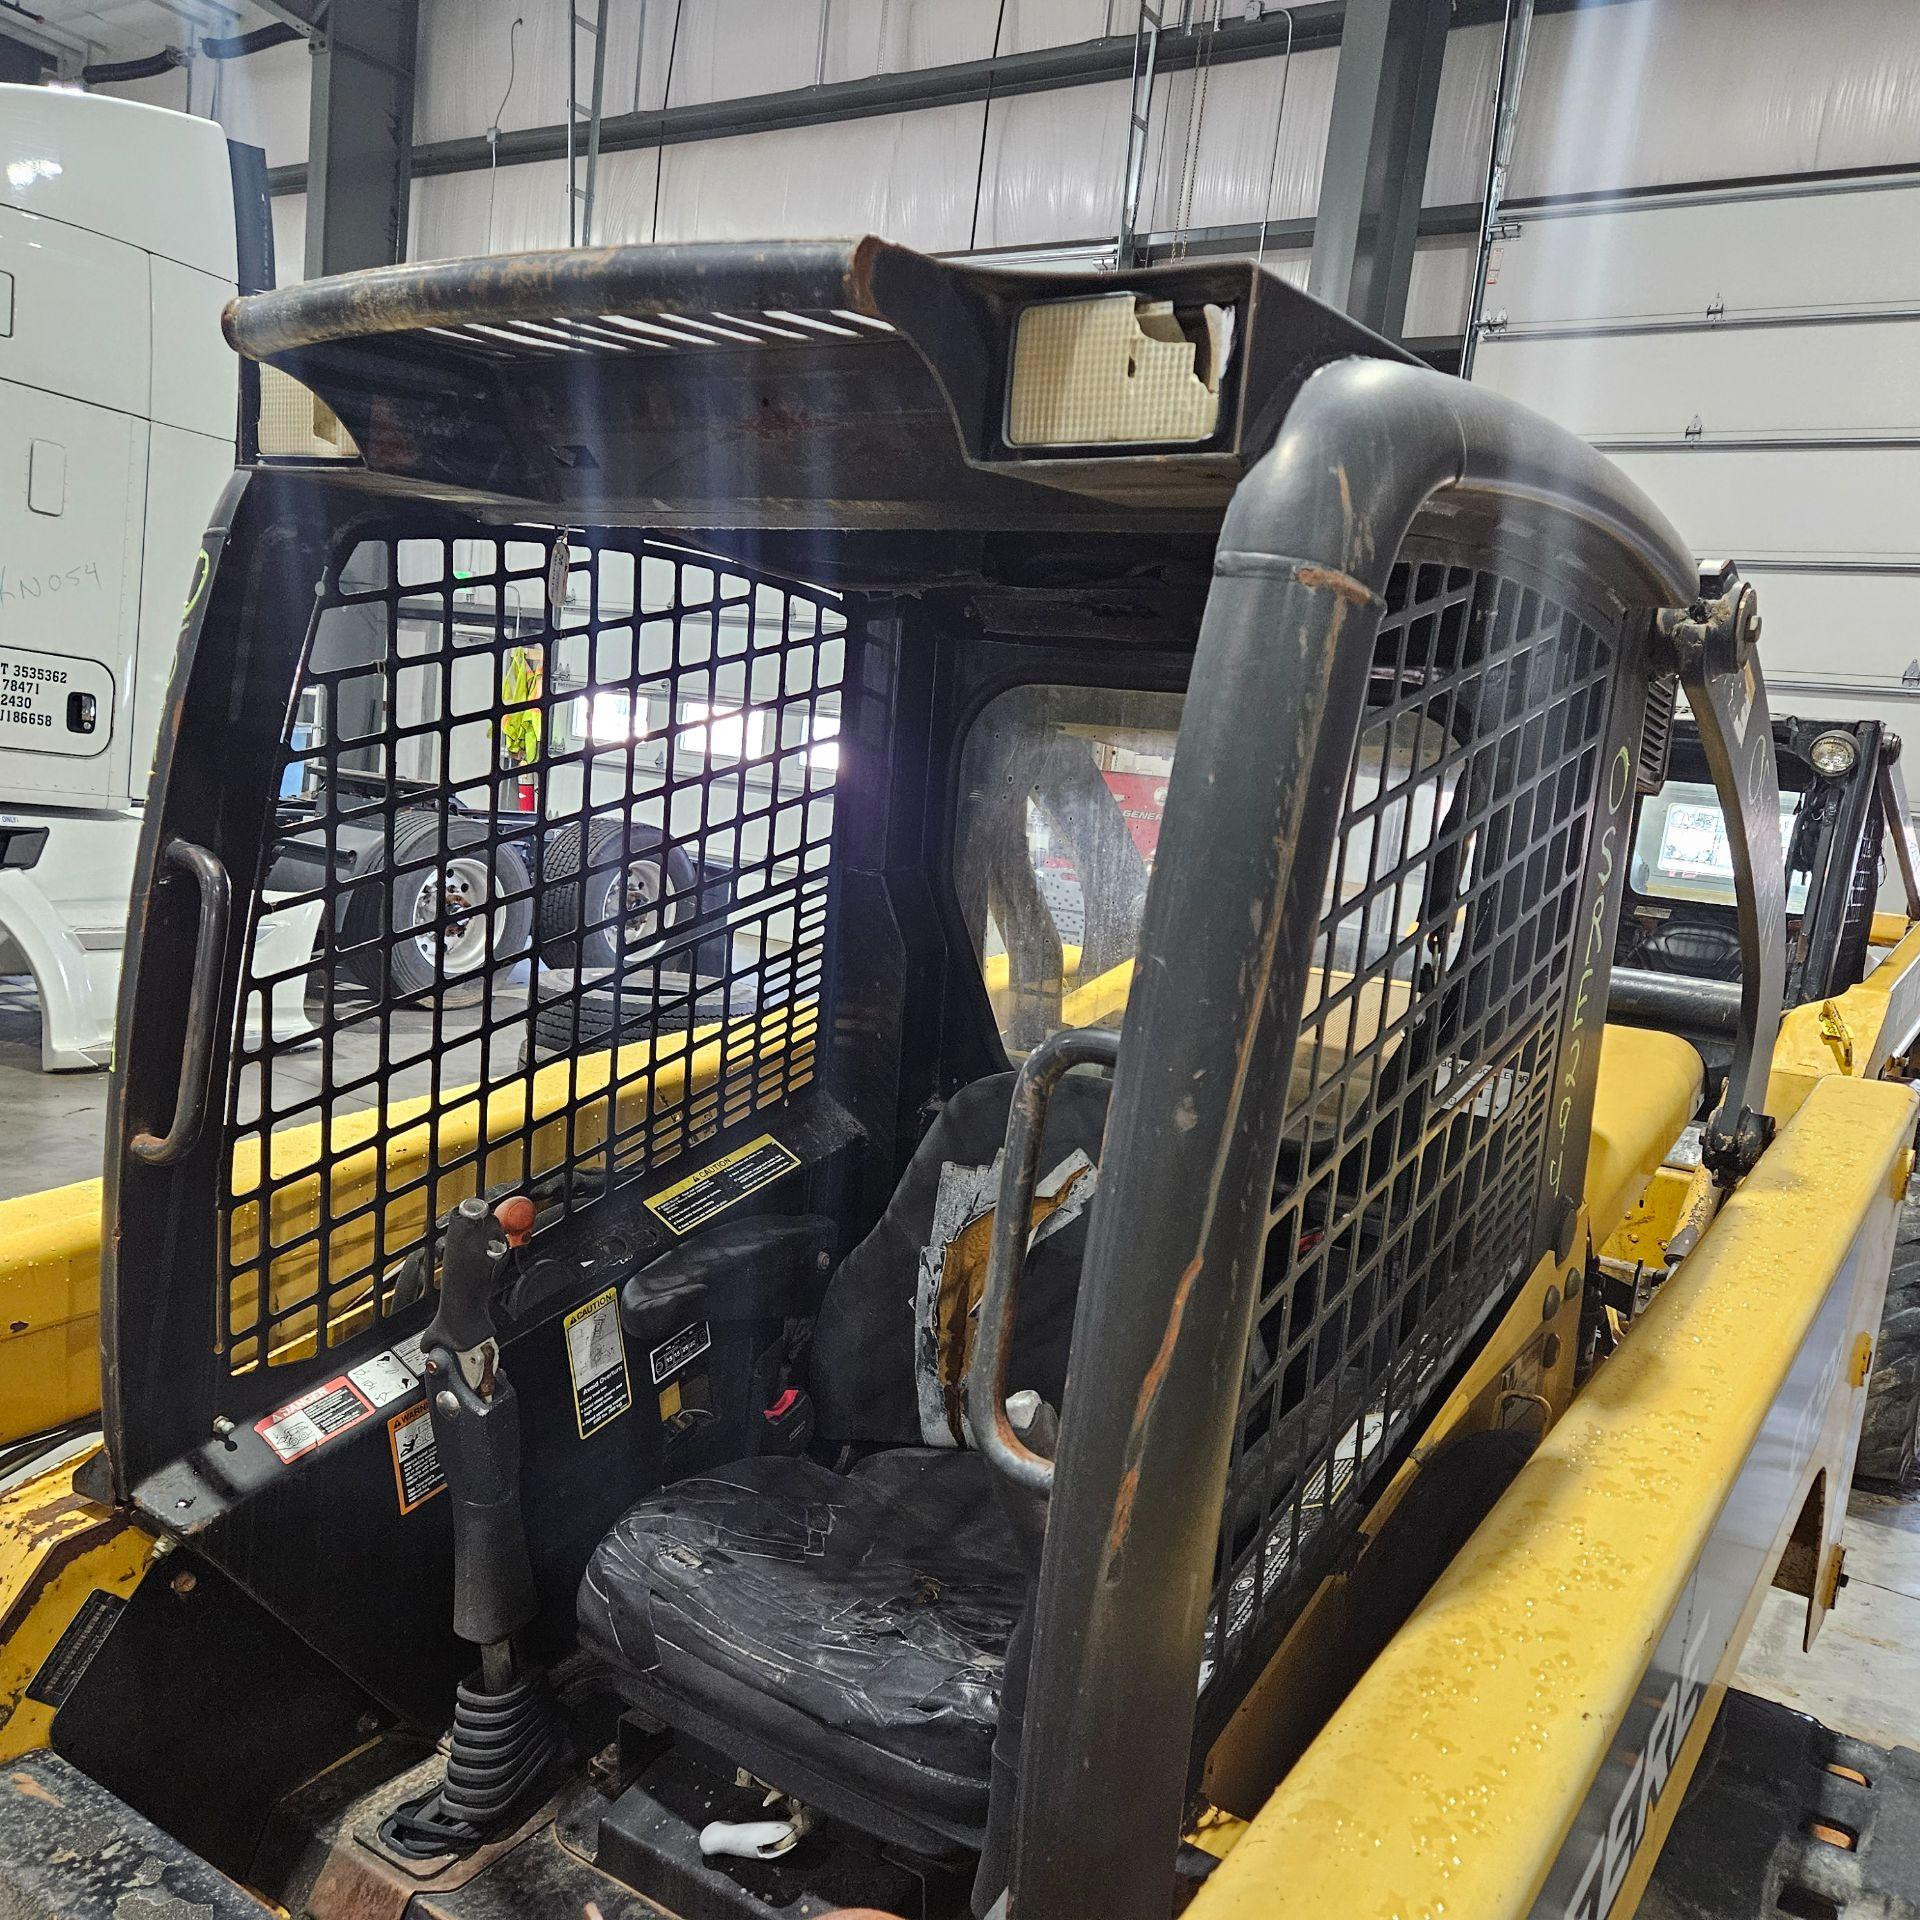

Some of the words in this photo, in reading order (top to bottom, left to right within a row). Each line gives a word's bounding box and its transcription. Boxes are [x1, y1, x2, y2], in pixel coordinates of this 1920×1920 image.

[14, 665, 67, 684] 3535362
[3, 679, 39, 695] 78471
[0, 694, 32, 709] 2430
[699, 1157, 732, 1178] CAUTION
[576, 1292, 612, 1319] CAUTION
[583, 1380, 599, 1395] Avoid
[599, 1365, 623, 1384] Overturn
